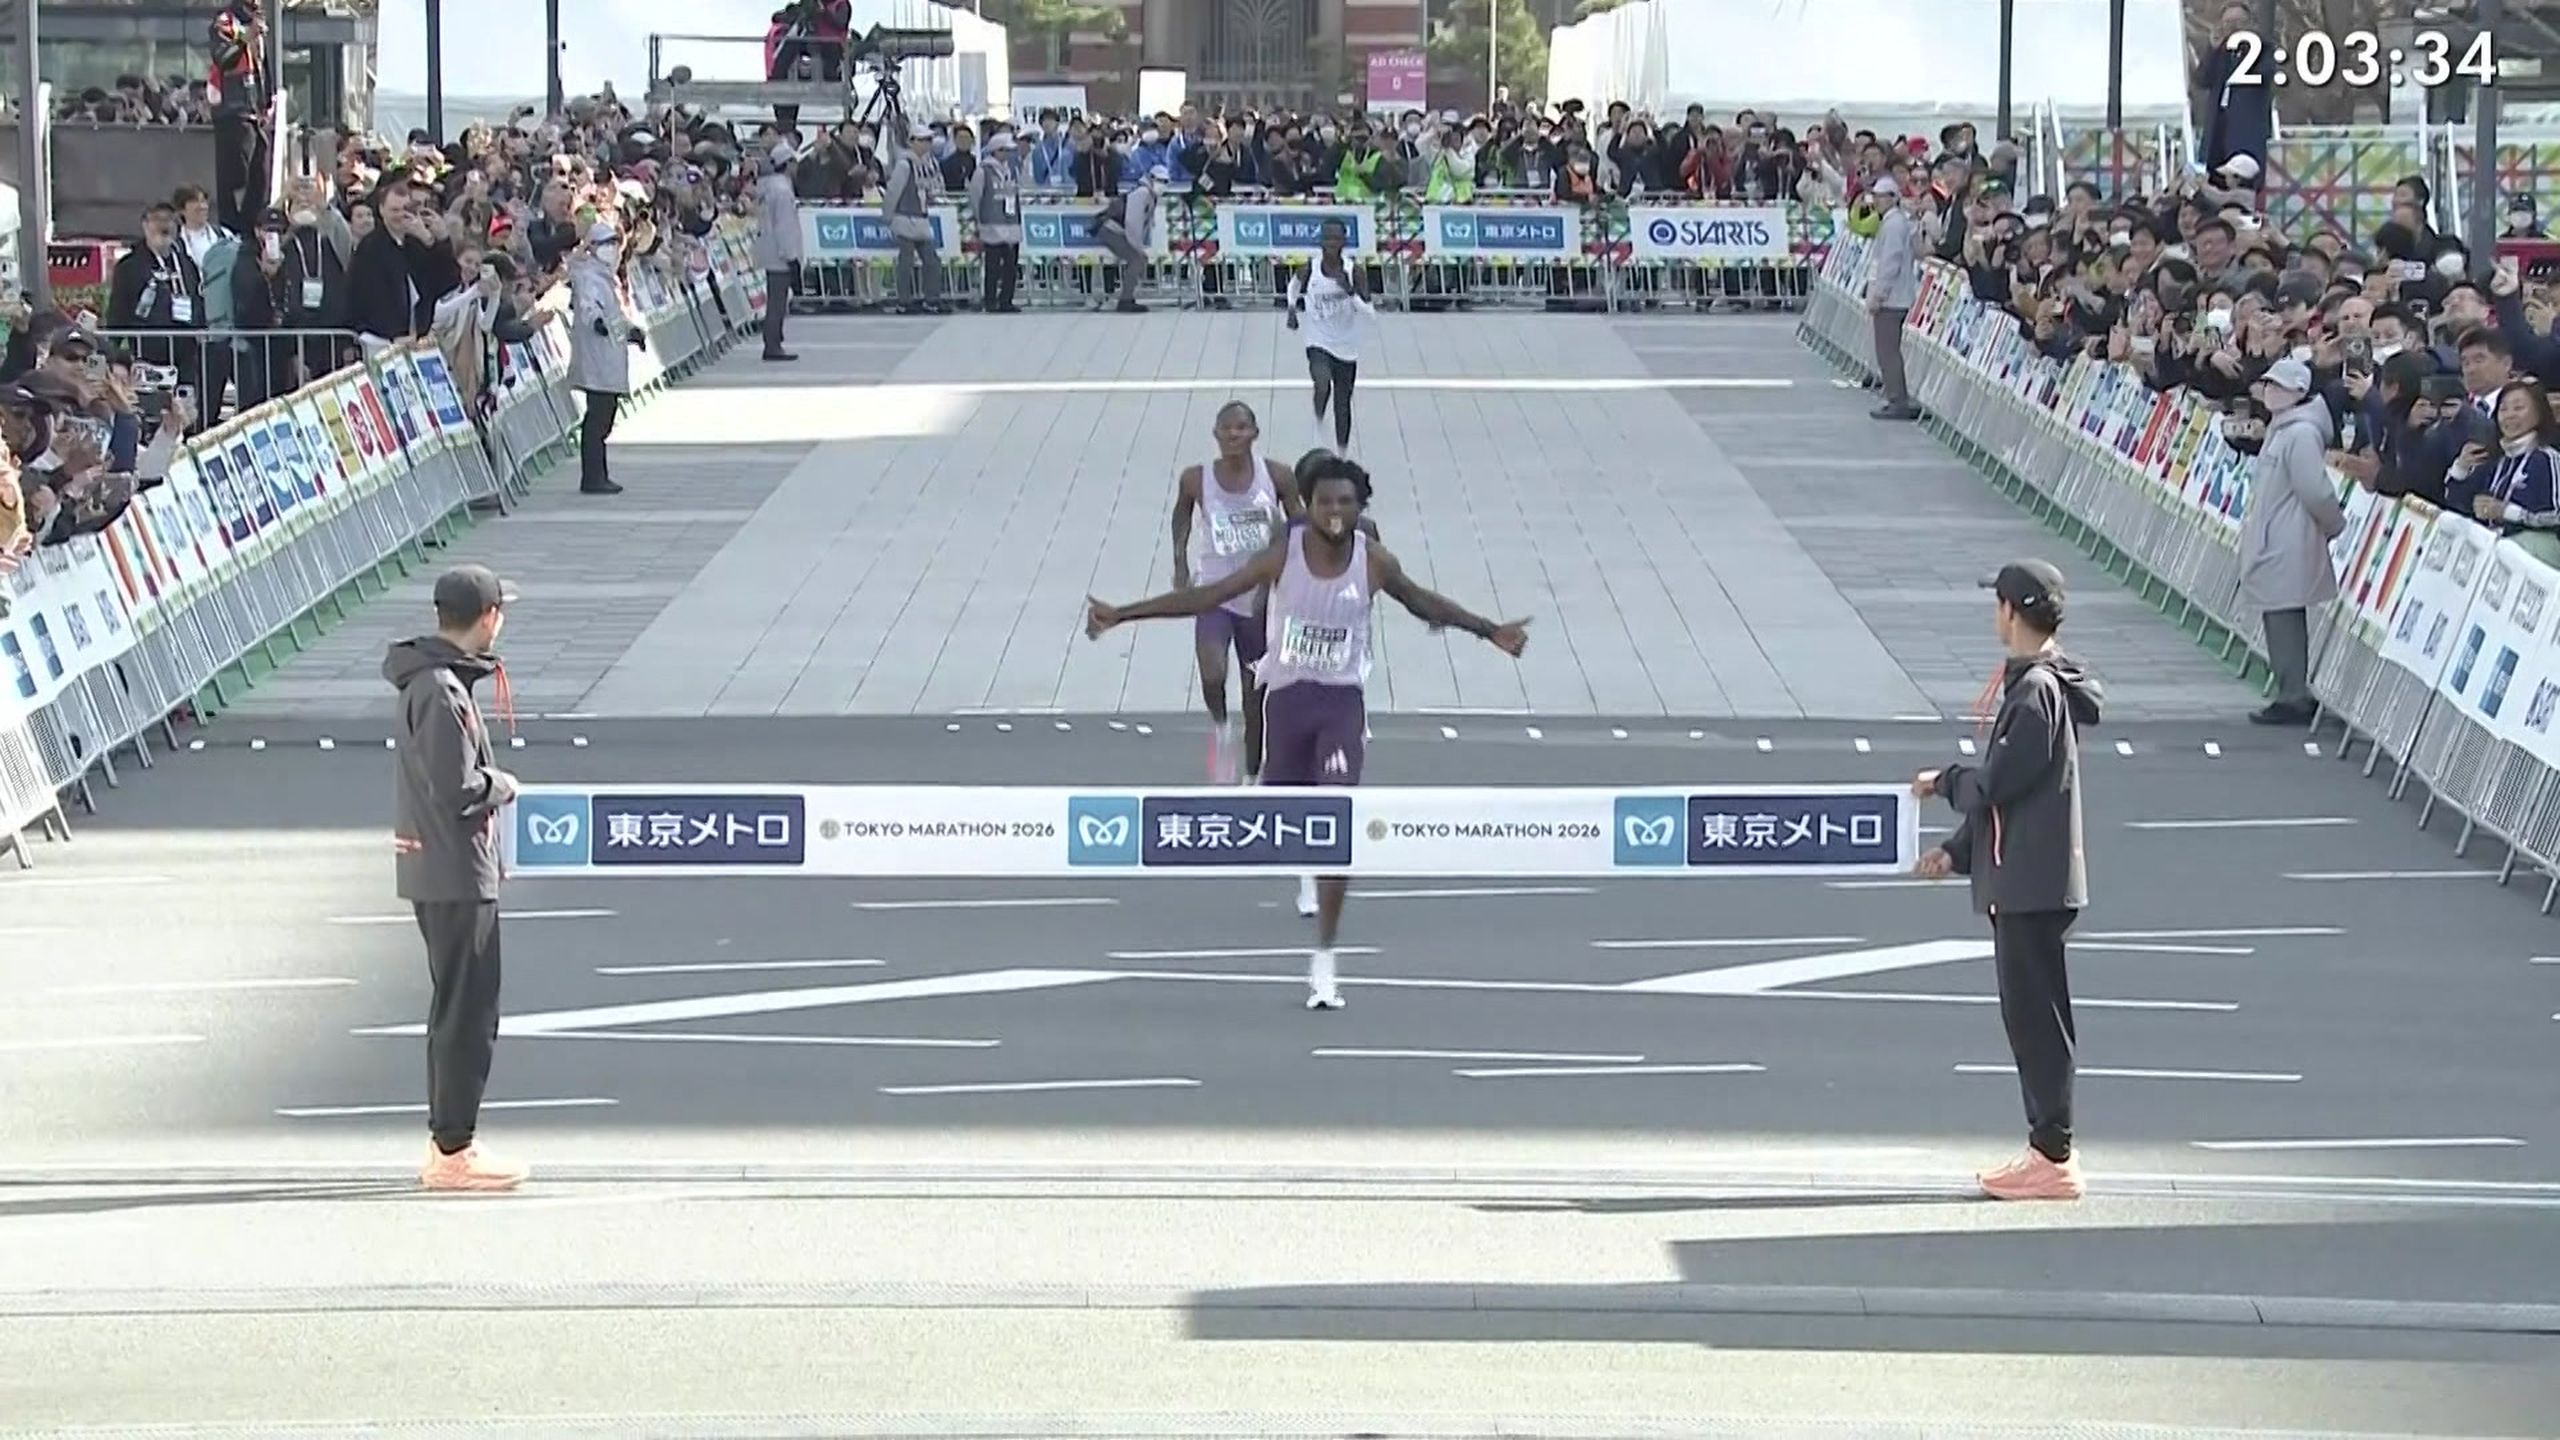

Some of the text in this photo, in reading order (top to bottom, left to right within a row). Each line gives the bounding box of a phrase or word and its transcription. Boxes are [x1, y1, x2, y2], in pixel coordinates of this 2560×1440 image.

[1484, 222, 1556, 239] 東京メトロ
[1681, 219, 1770, 246] STARTS
[607, 812, 790, 848] 東京メトロ
[844, 821, 1055, 837] TOKYO MARATHON 2026
[1157, 813, 1337, 848] 東京メトロ
[1392, 822, 1601, 838] TOKYO MARATHON 2026
[1703, 812, 1882, 848] 東京メトロ
